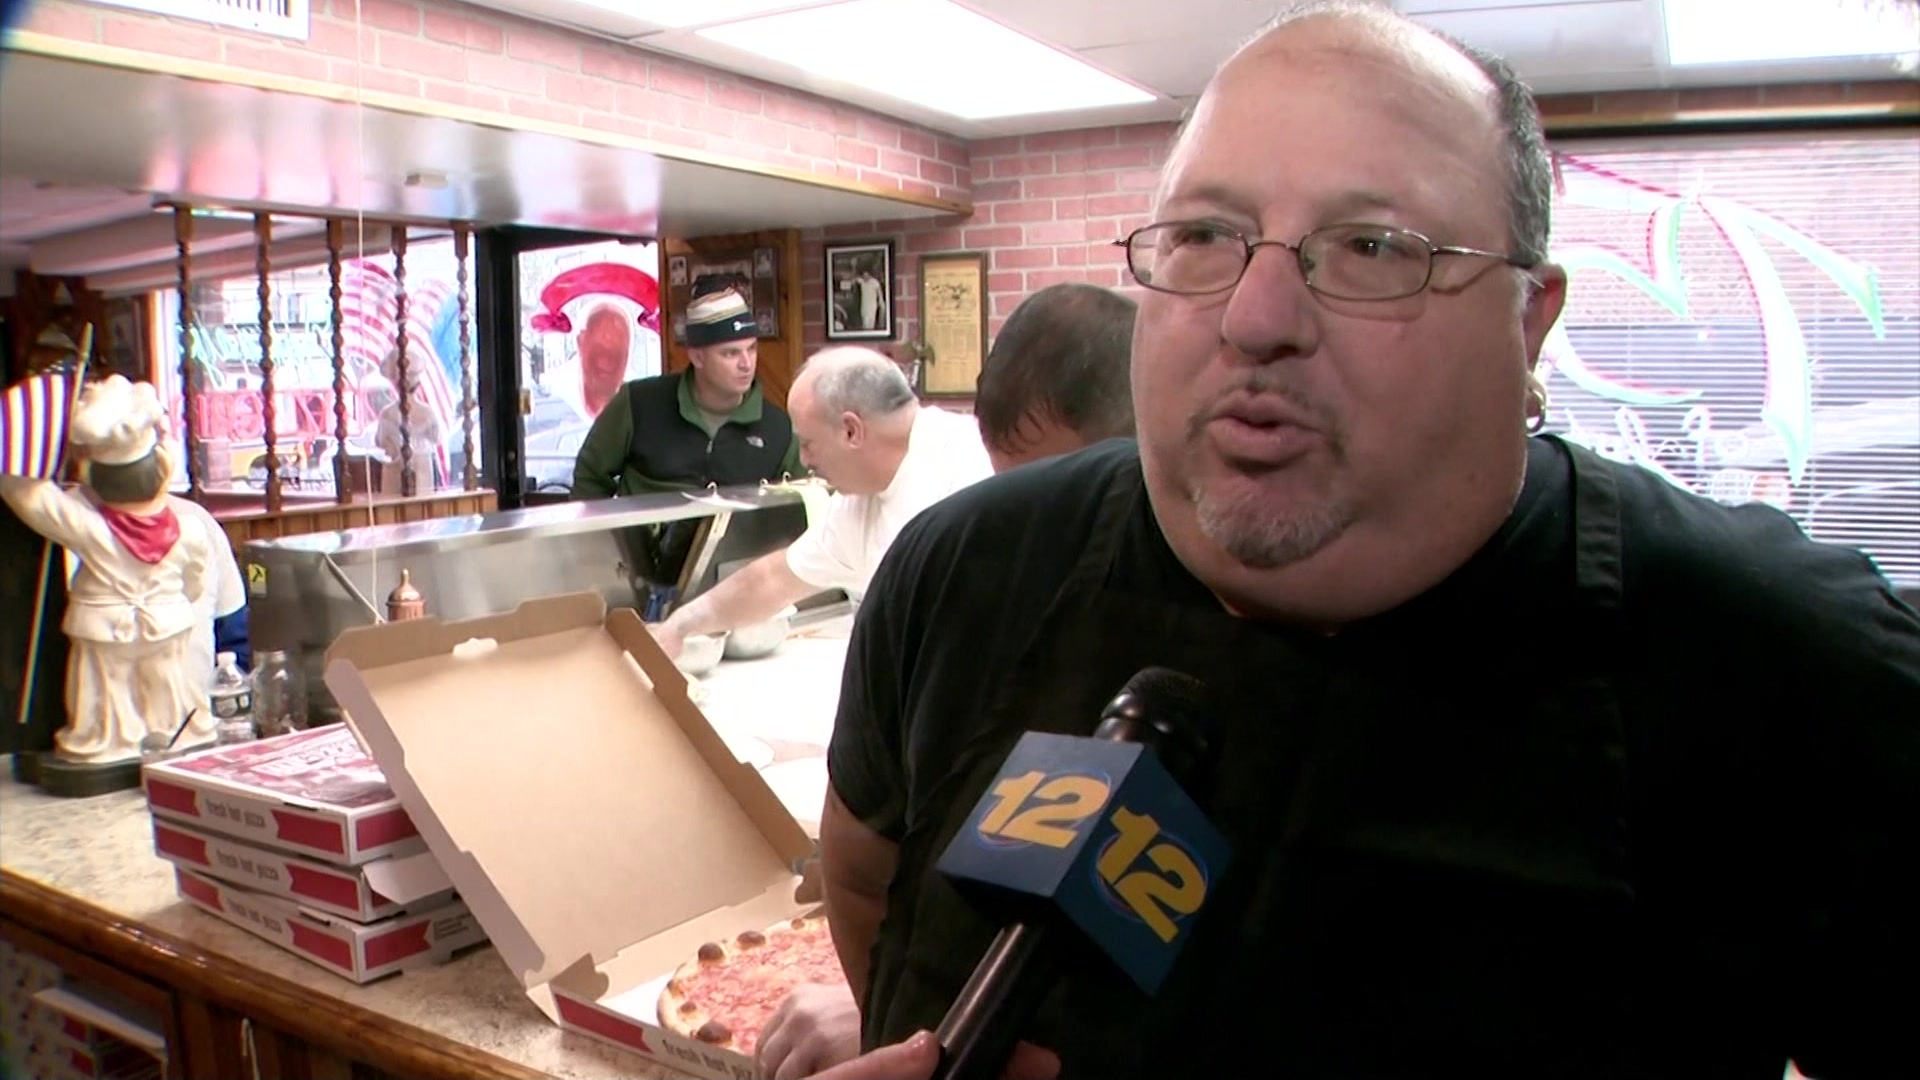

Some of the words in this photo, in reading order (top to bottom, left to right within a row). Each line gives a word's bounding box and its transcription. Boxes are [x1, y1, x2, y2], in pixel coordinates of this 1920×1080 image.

[228, 802, 242, 822] hot
[243, 809, 266, 829] pizza
[977, 769, 1111, 849] 12
[239, 855, 255, 874] hot
[257, 864, 279, 881] pizza
[1096, 804, 1208, 943] 12
[662, 1039, 701, 1066] fresh
[702, 1052, 730, 1074] hot
